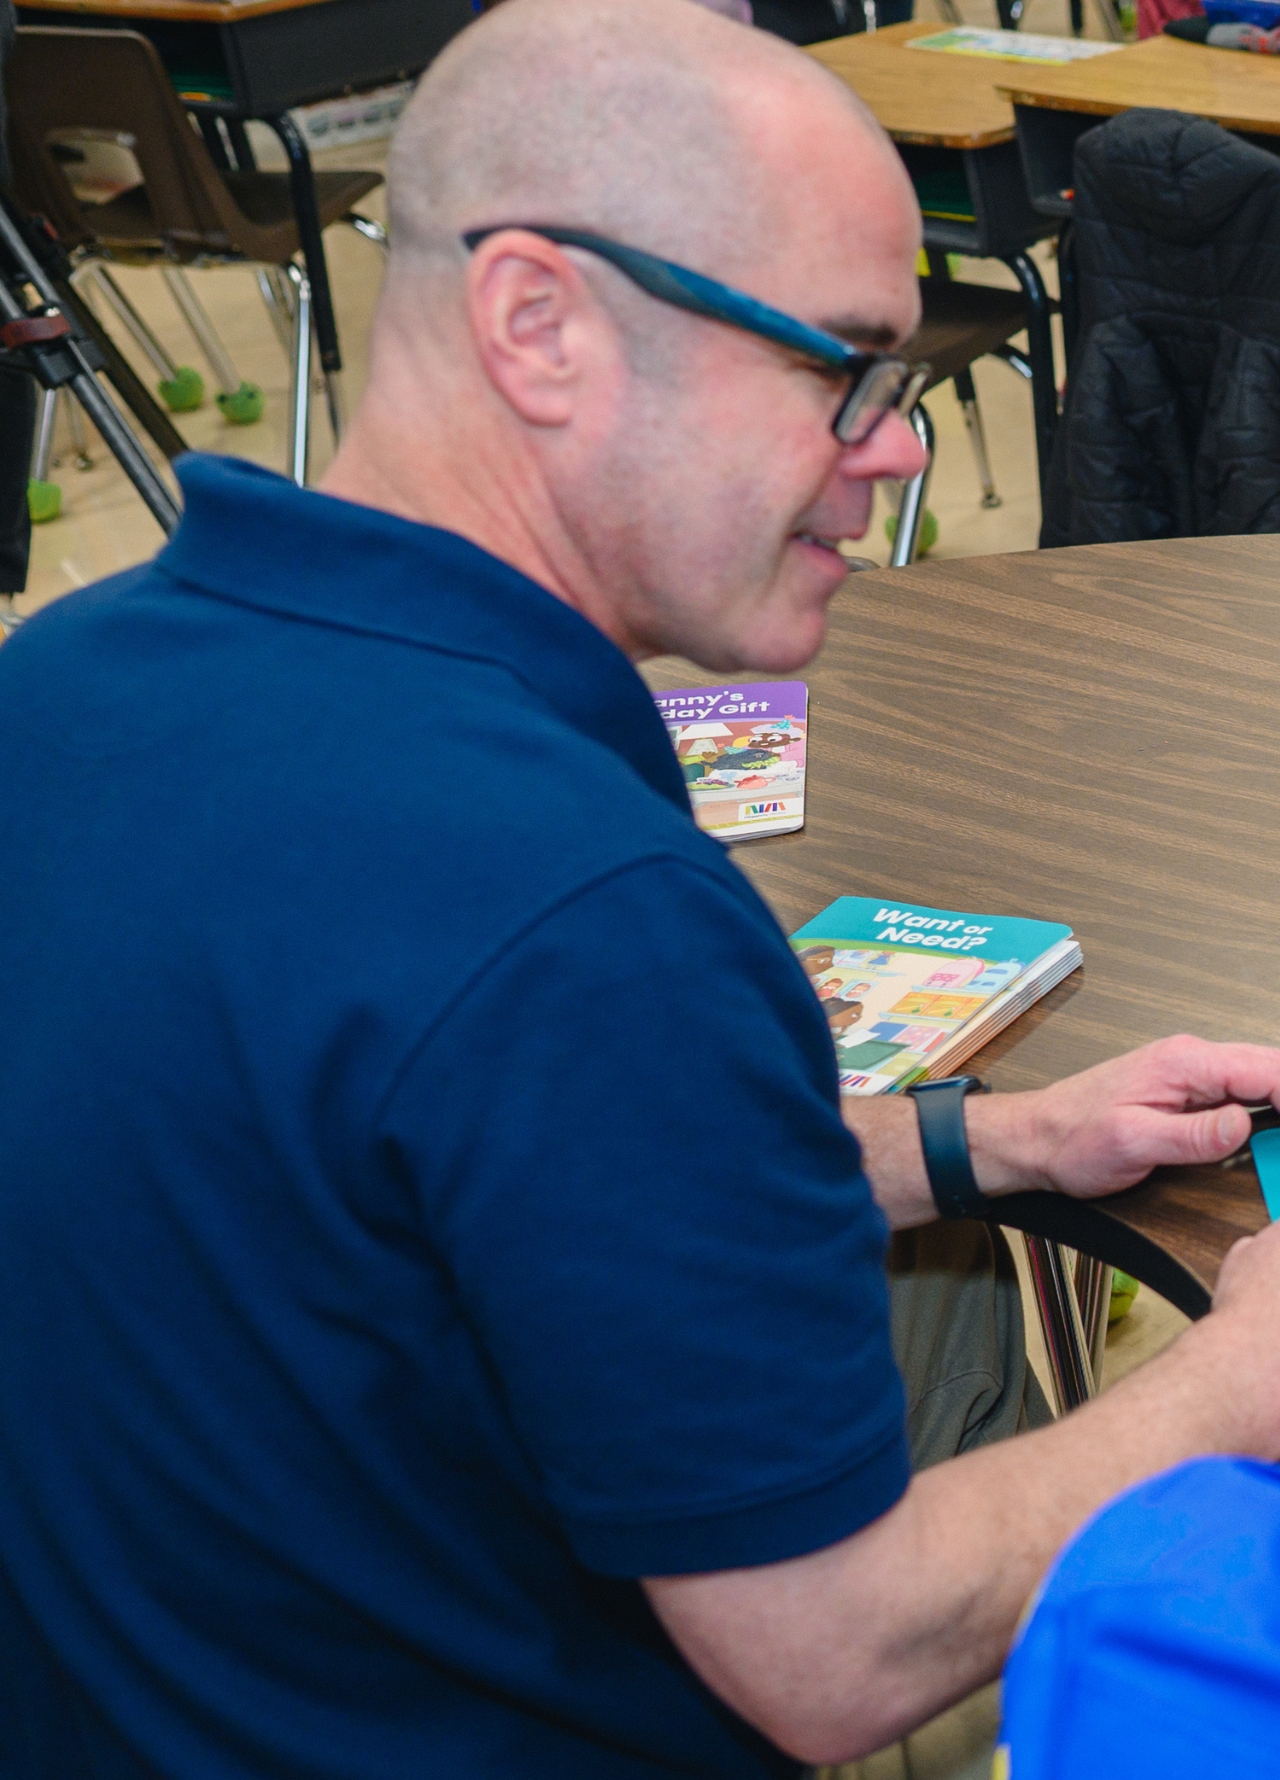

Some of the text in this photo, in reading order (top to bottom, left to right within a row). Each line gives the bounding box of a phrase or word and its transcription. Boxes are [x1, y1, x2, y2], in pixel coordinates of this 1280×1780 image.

[719, 701, 771, 714] Gift
[873, 908, 994, 935] Want or
[875, 927, 988, 950] Need?
